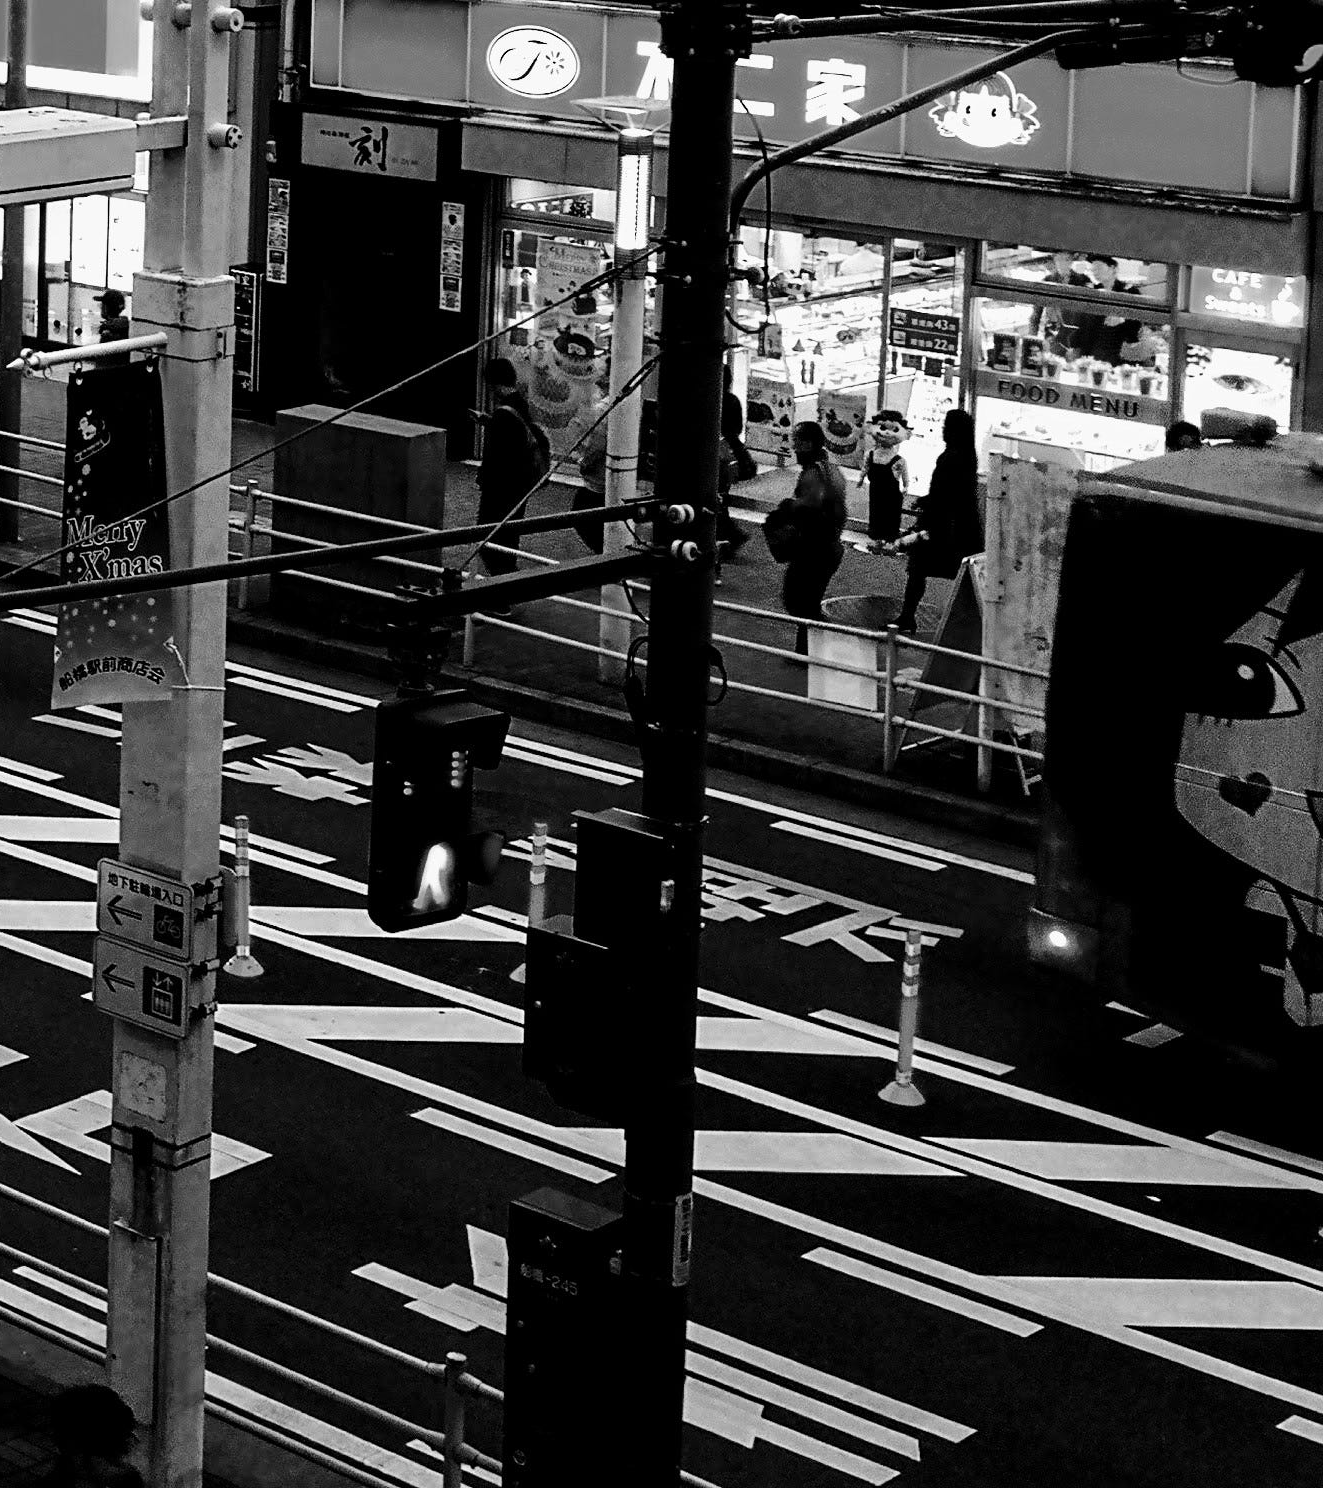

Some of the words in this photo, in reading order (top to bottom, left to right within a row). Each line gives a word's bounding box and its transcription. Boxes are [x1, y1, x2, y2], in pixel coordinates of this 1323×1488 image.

[1211, 268, 1263, 289] CAFE
[997, 379, 1060, 405] FOOD
[1069, 392, 1140, 418] MENU
[66, 515, 147, 551] Merry
[78, 547, 164, 583] X'mas
[58, 655, 166, 692] 船橋駅前商店会
